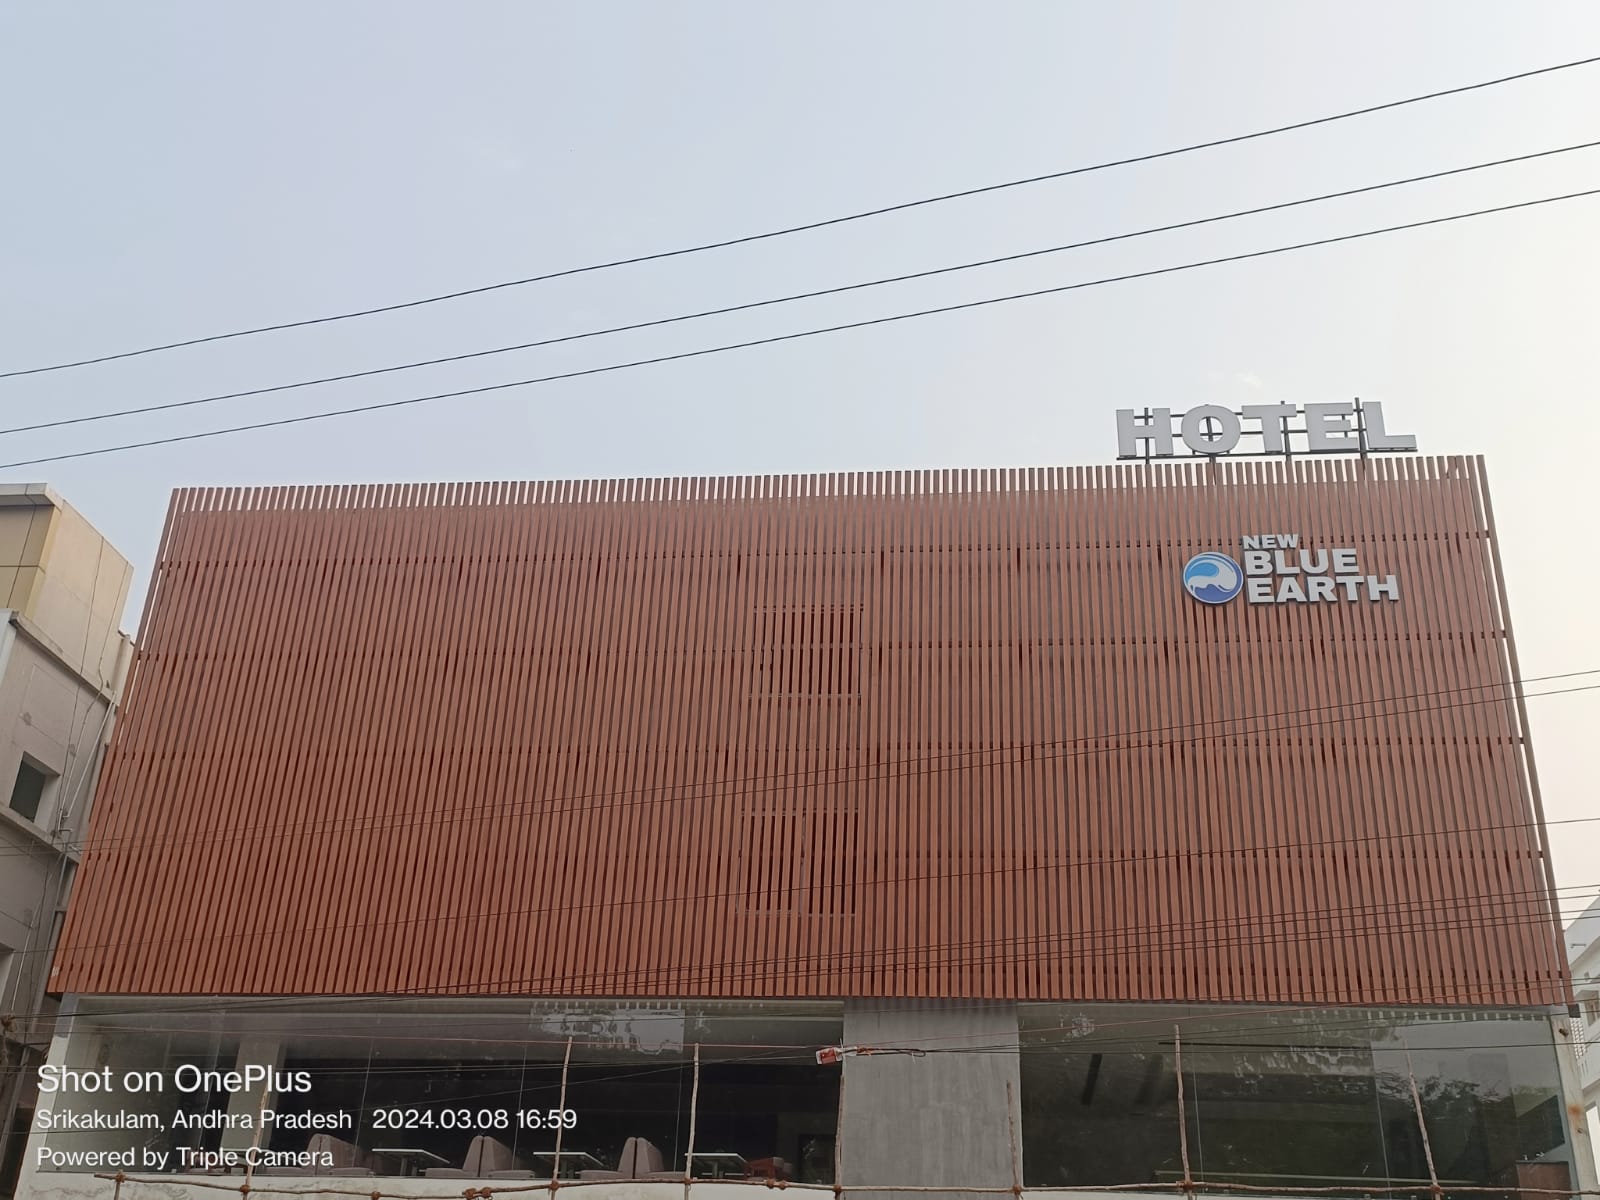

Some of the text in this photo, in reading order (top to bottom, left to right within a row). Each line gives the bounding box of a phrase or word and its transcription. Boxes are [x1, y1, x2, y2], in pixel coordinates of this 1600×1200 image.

[1116, 402, 1417, 456] HOTEL
[1243, 534, 1298, 550] NEW
[1244, 549, 1359, 575] BLUE
[1247, 575, 1399, 603] EARTH
